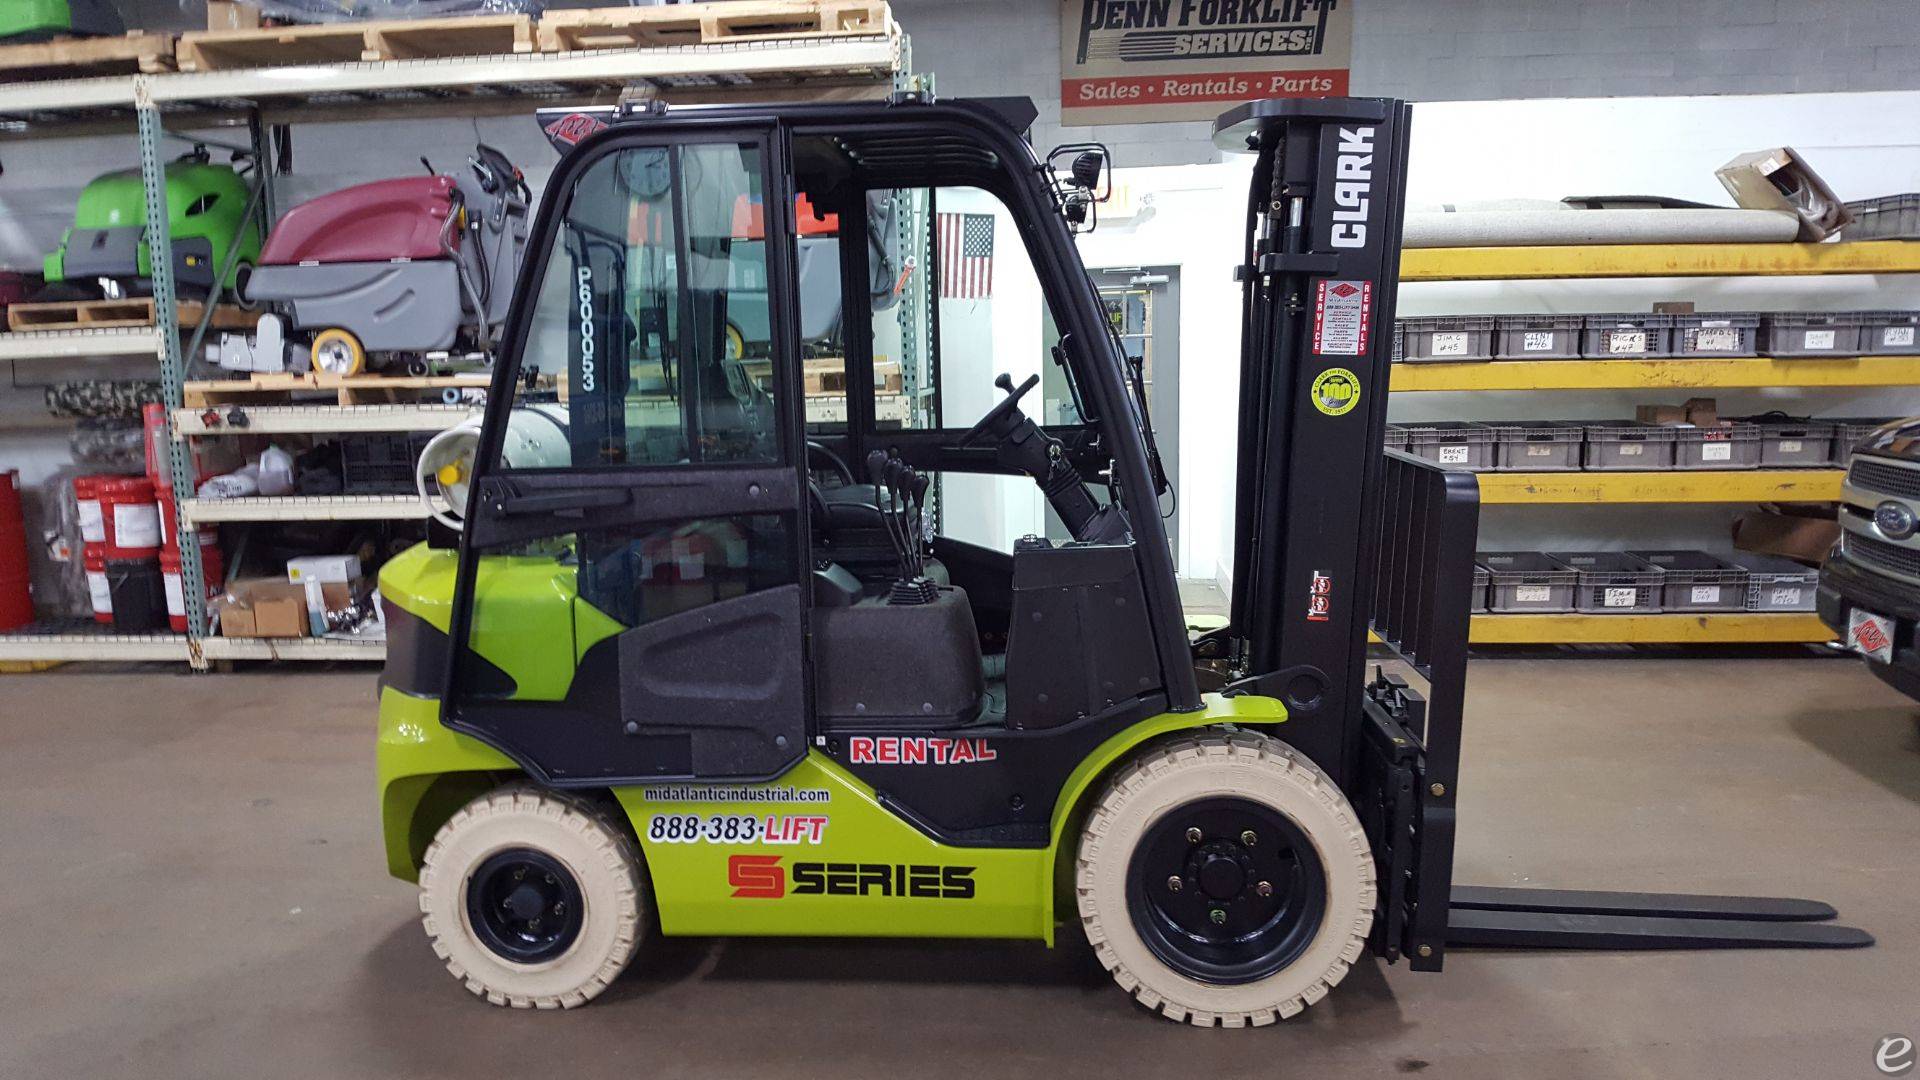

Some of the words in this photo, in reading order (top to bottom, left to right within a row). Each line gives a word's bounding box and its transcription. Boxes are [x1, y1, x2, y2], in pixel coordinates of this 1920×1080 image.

[1174, 30, 1305, 54] SERVICES
[1079, 82, 1140, 100] Sales
[1162, 77, 1249, 97] Rentals
[1269, 76, 1333, 93] Parts
[1330, 127, 1375, 248] CLARK
[577, 265, 595, 392] P600053
[1314, 283, 1325, 350] SERVICE
[1359, 284, 1370, 351] RENTALS
[1436, 334, 1453, 342] JIM
[1526, 340, 1547, 349] #46
[1321, 383, 1351, 400] 100
[851, 737, 997, 764] RENTAL
[645, 787, 829, 803] midatlanticindustrial.com
[728, 855, 785, 899] S
[791, 862, 978, 899] SERIES
